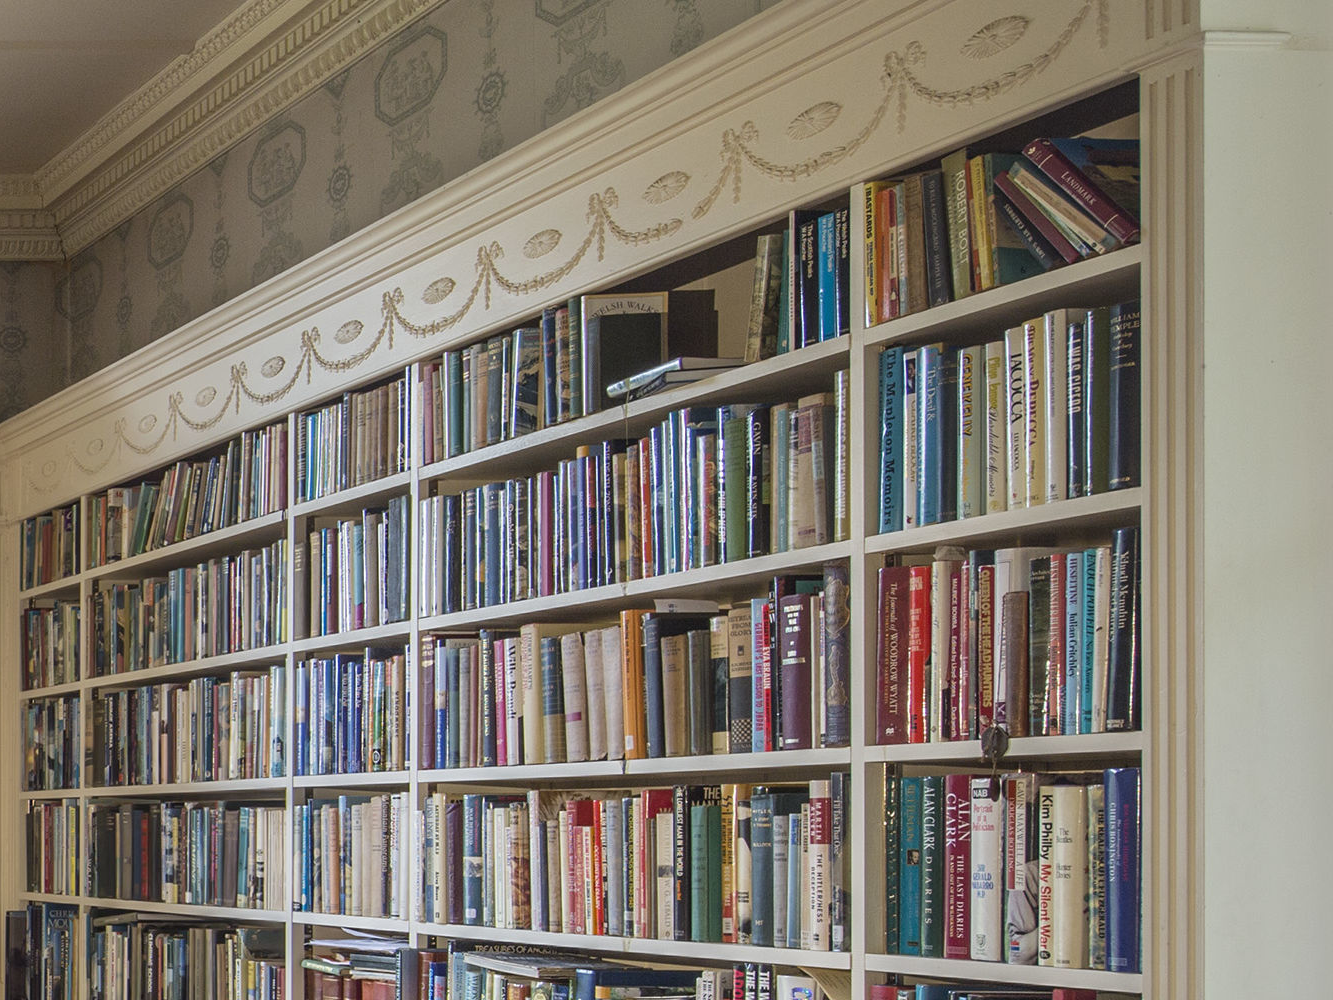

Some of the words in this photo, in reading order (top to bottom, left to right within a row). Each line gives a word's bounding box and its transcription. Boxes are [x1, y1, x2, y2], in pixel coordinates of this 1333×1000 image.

[956, 170, 967, 223] ROBERT
[1060, 171, 1097, 205] LANDMARK
[960, 230, 968, 264] BOLT
[886, 351, 896, 377] The
[884, 382, 895, 454] Mapleson
[753, 422, 761, 455] GAVIN
[884, 460, 894, 524] Memoirs
[1069, 558, 1077, 605] HESELTINE
[1119, 551, 1129, 582] Yehudi
[889, 597, 897, 622] Journals
[1118, 585, 1128, 628] Menuhin
[890, 624, 897, 632] of
[1068, 612, 1077, 638] Julian
[890, 633, 898, 681] WOODROW
[1067, 640, 1077, 678] Critchley
[889, 684, 897, 715] WYATT
[703, 787, 721, 799] THE
[924, 786, 935, 814] ALAN
[973, 788, 988, 798] NAB
[1042, 795, 1052, 818] Kim
[924, 817, 935, 850] CLARK
[946, 793, 956, 848] CLARK
[958, 799, 970, 841] ALAN
[1016, 812, 1024, 856] MAXWELL
[1041, 823, 1052, 860] Philby
[956, 855, 964, 873] THE
[1040, 864, 1051, 882] My
[956, 877, 964, 898] LAST
[1040, 886, 1051, 921] Silent
[1040, 925, 1050, 949] War
[470, 976, 478, 999] WHO'S
[746, 971, 756, 989] THE
[759, 972, 769, 990] THE
